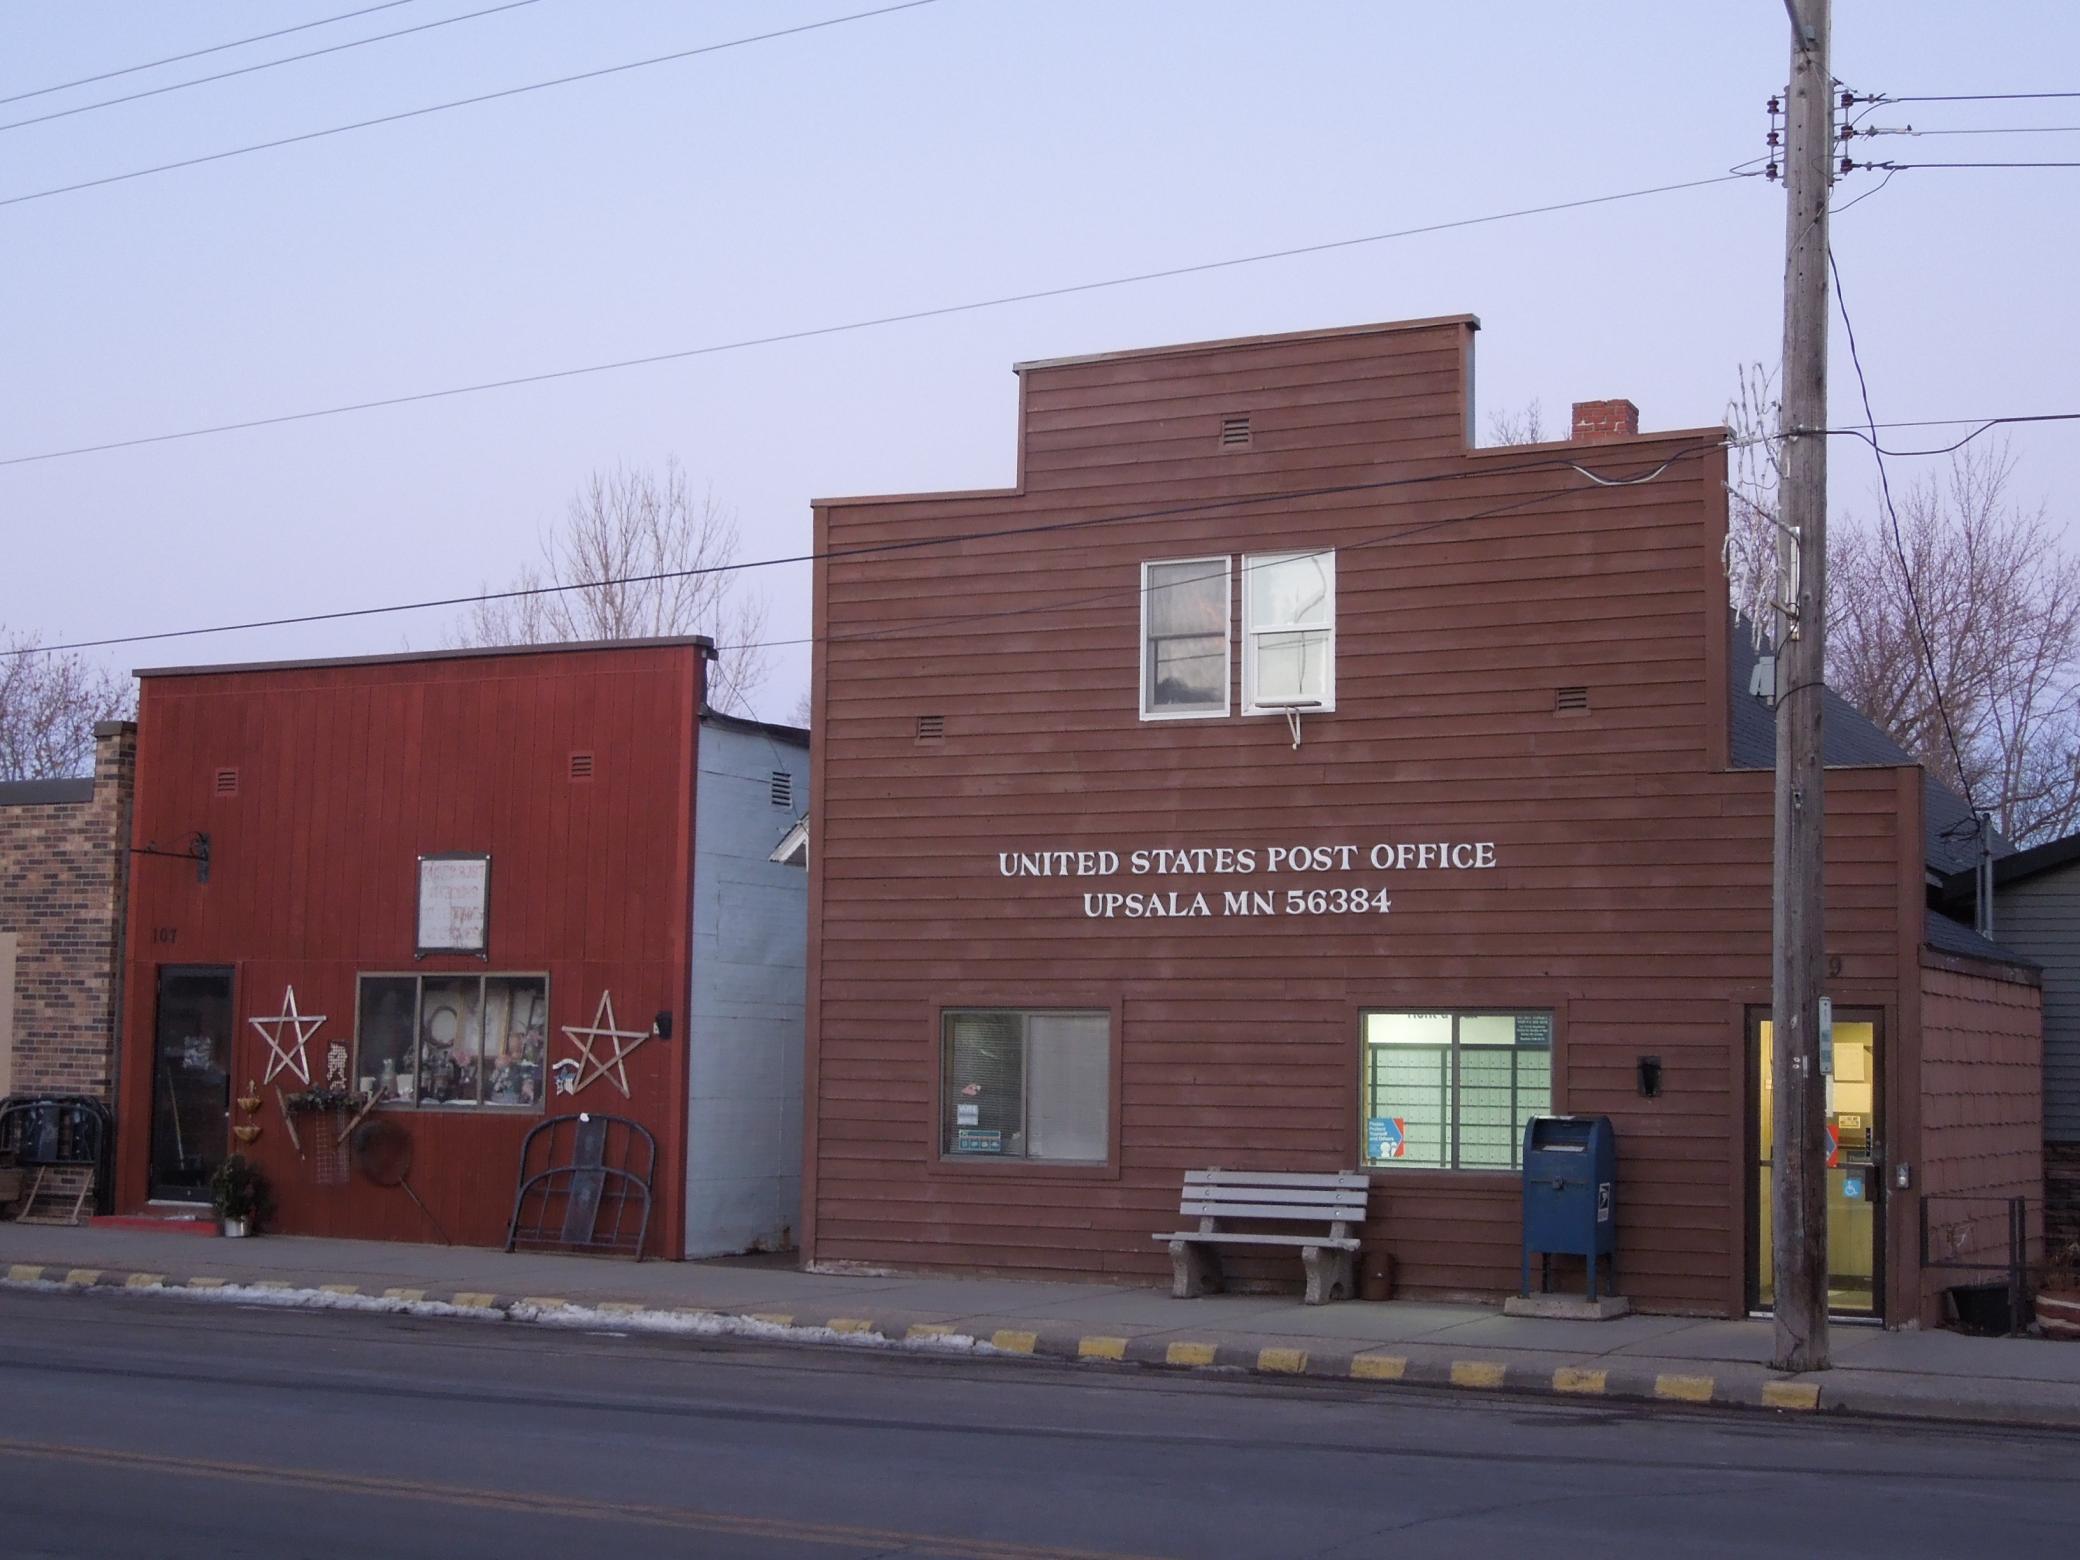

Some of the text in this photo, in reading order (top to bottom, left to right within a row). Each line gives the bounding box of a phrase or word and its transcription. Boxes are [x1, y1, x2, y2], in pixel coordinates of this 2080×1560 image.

[999, 842, 1497, 876] UNITED STATES POST OFFICE
[1084, 887, 1392, 917] UPSALA MN 56384
[153, 927, 177, 945] 107
